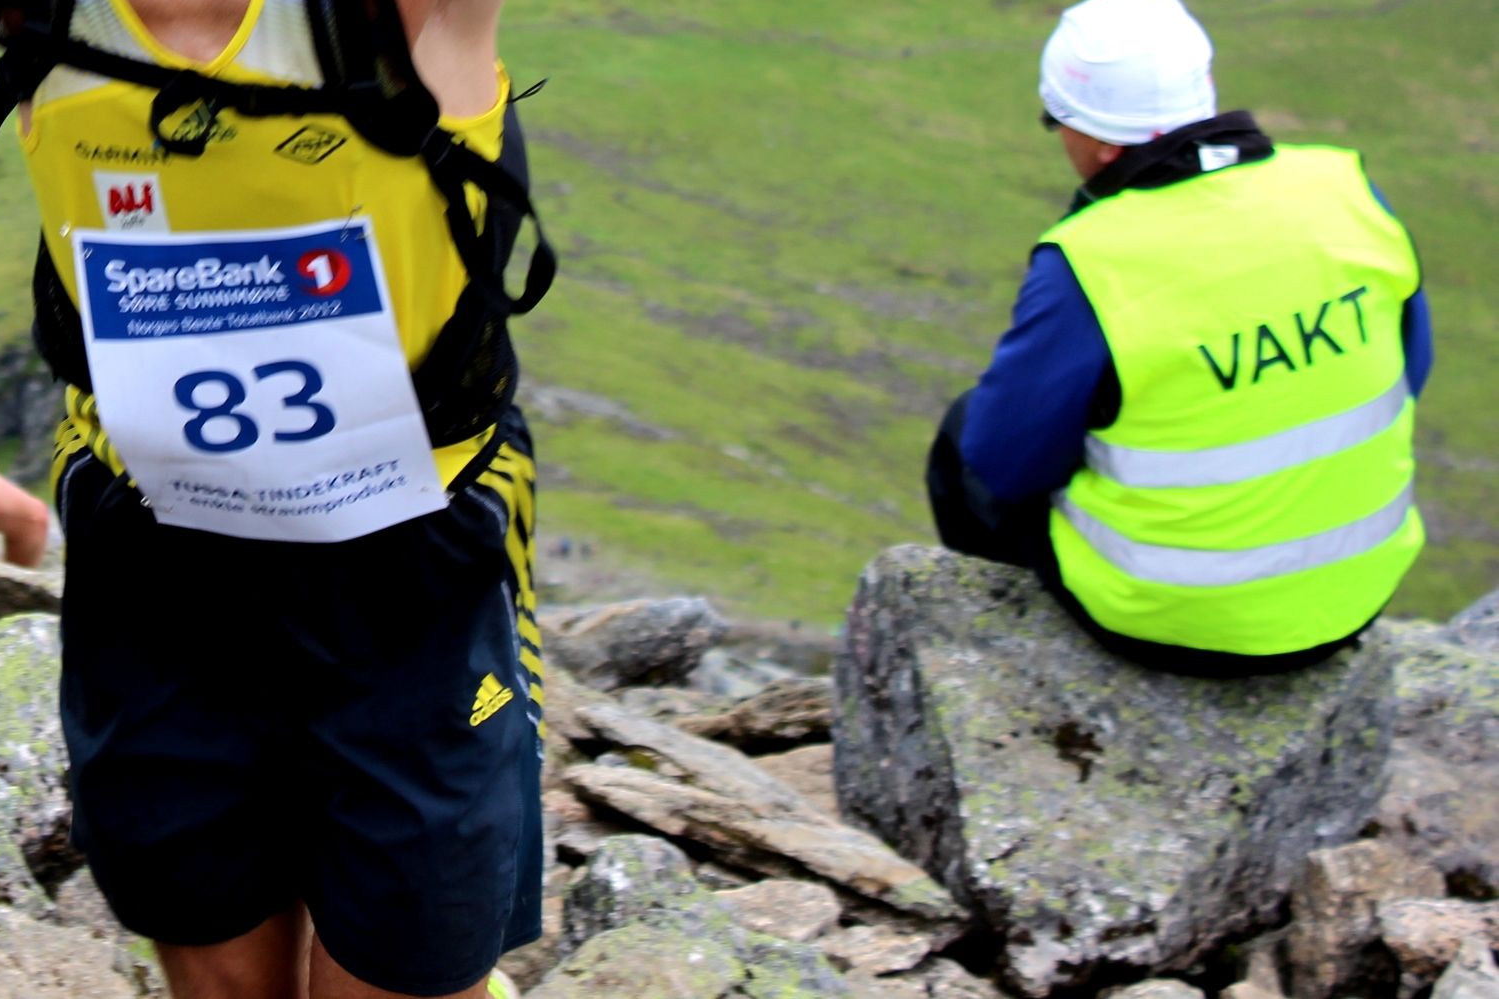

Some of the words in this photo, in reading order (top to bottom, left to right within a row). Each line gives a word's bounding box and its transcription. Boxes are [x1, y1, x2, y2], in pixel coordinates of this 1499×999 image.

[104, 254, 286, 296] SpareBank
[1197, 286, 1368, 392] VAKT
[173, 360, 337, 454] 83
